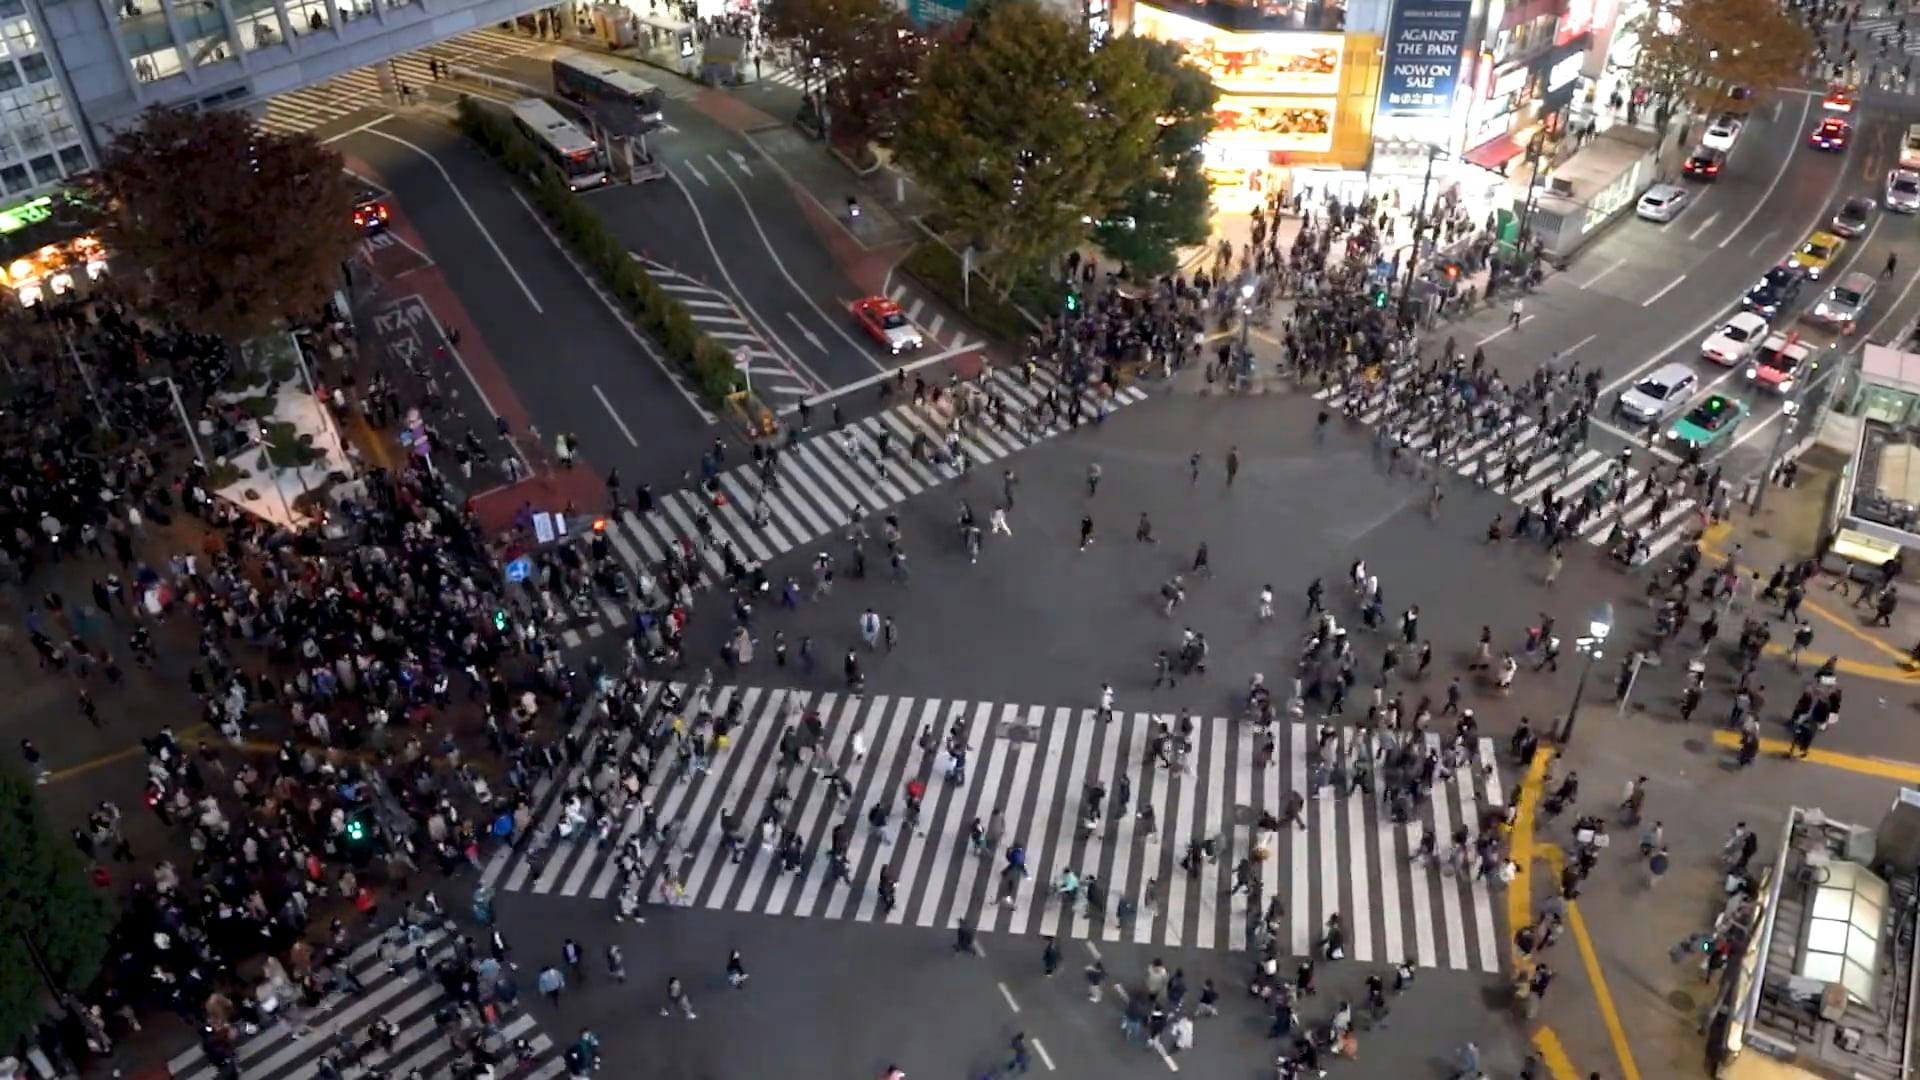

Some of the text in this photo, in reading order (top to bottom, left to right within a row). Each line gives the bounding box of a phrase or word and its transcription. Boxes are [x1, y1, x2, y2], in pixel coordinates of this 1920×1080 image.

[1400, 29, 1458, 41] AGAINST
[1396, 43, 1457, 56] THE PAIN
[1393, 64, 1451, 77] NOW ON
[1405, 76, 1435, 88] SALE
